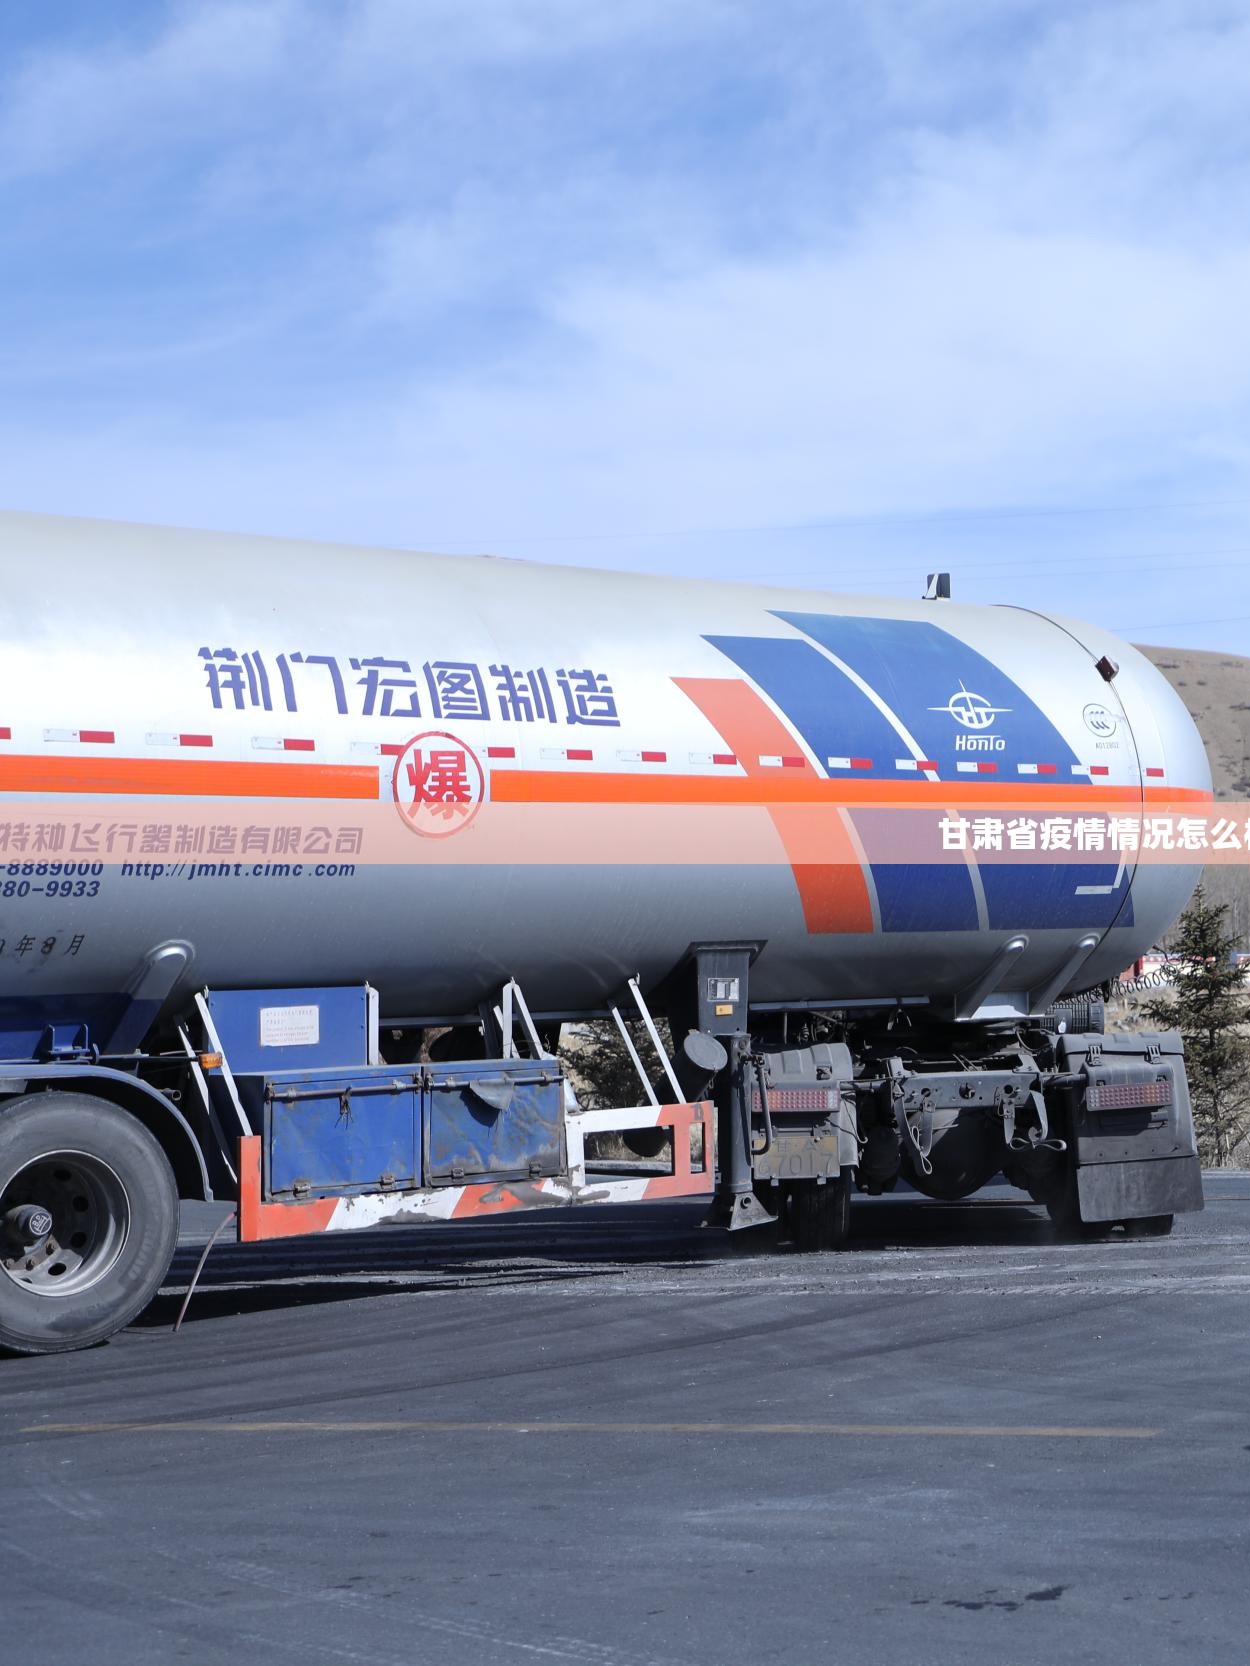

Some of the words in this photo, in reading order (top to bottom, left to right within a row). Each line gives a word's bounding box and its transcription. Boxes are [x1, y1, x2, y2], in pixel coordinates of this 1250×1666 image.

[197, 646, 621, 727] 荆门宏图制造
[405, 748, 473, 821] 爆
[0, 880, 101, 898] 80-9933
